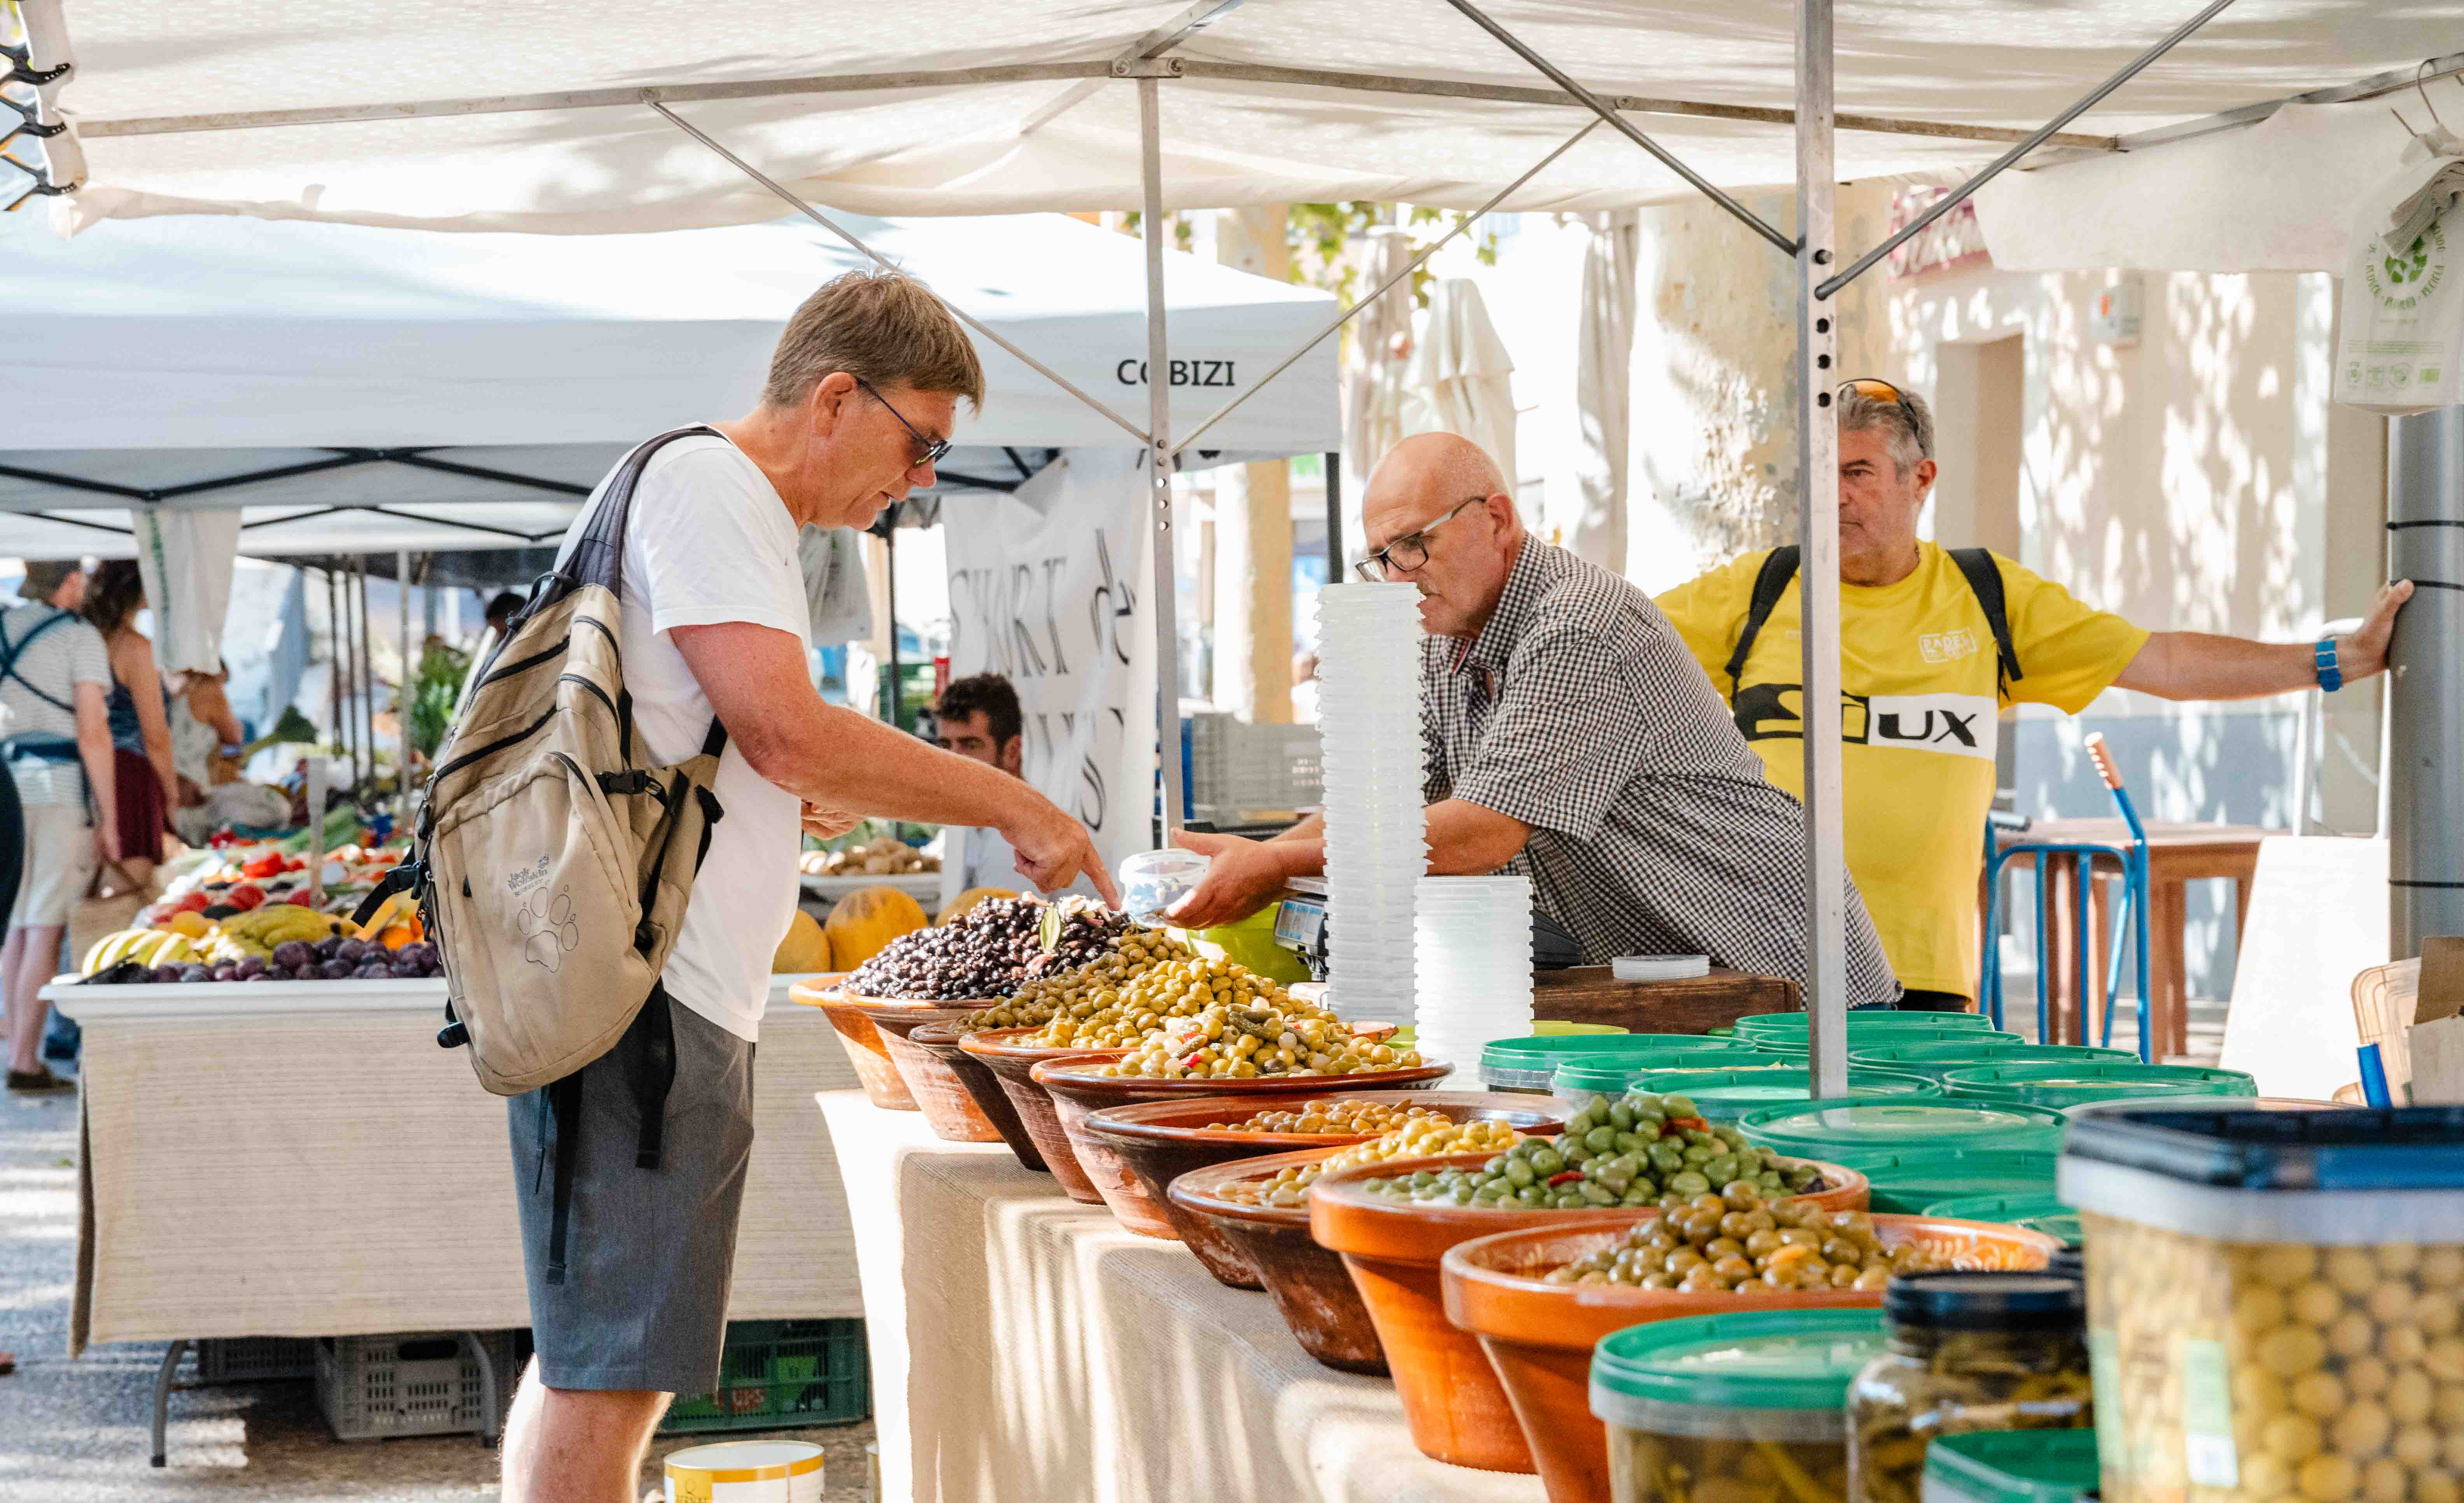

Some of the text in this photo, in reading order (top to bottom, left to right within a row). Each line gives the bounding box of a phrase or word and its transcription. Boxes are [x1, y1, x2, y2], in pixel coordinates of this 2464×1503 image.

[1117, 359, 1236, 386] CBIZI
[508, 868, 529, 882] Jack
[508, 869, 548, 890] Wolfskin
